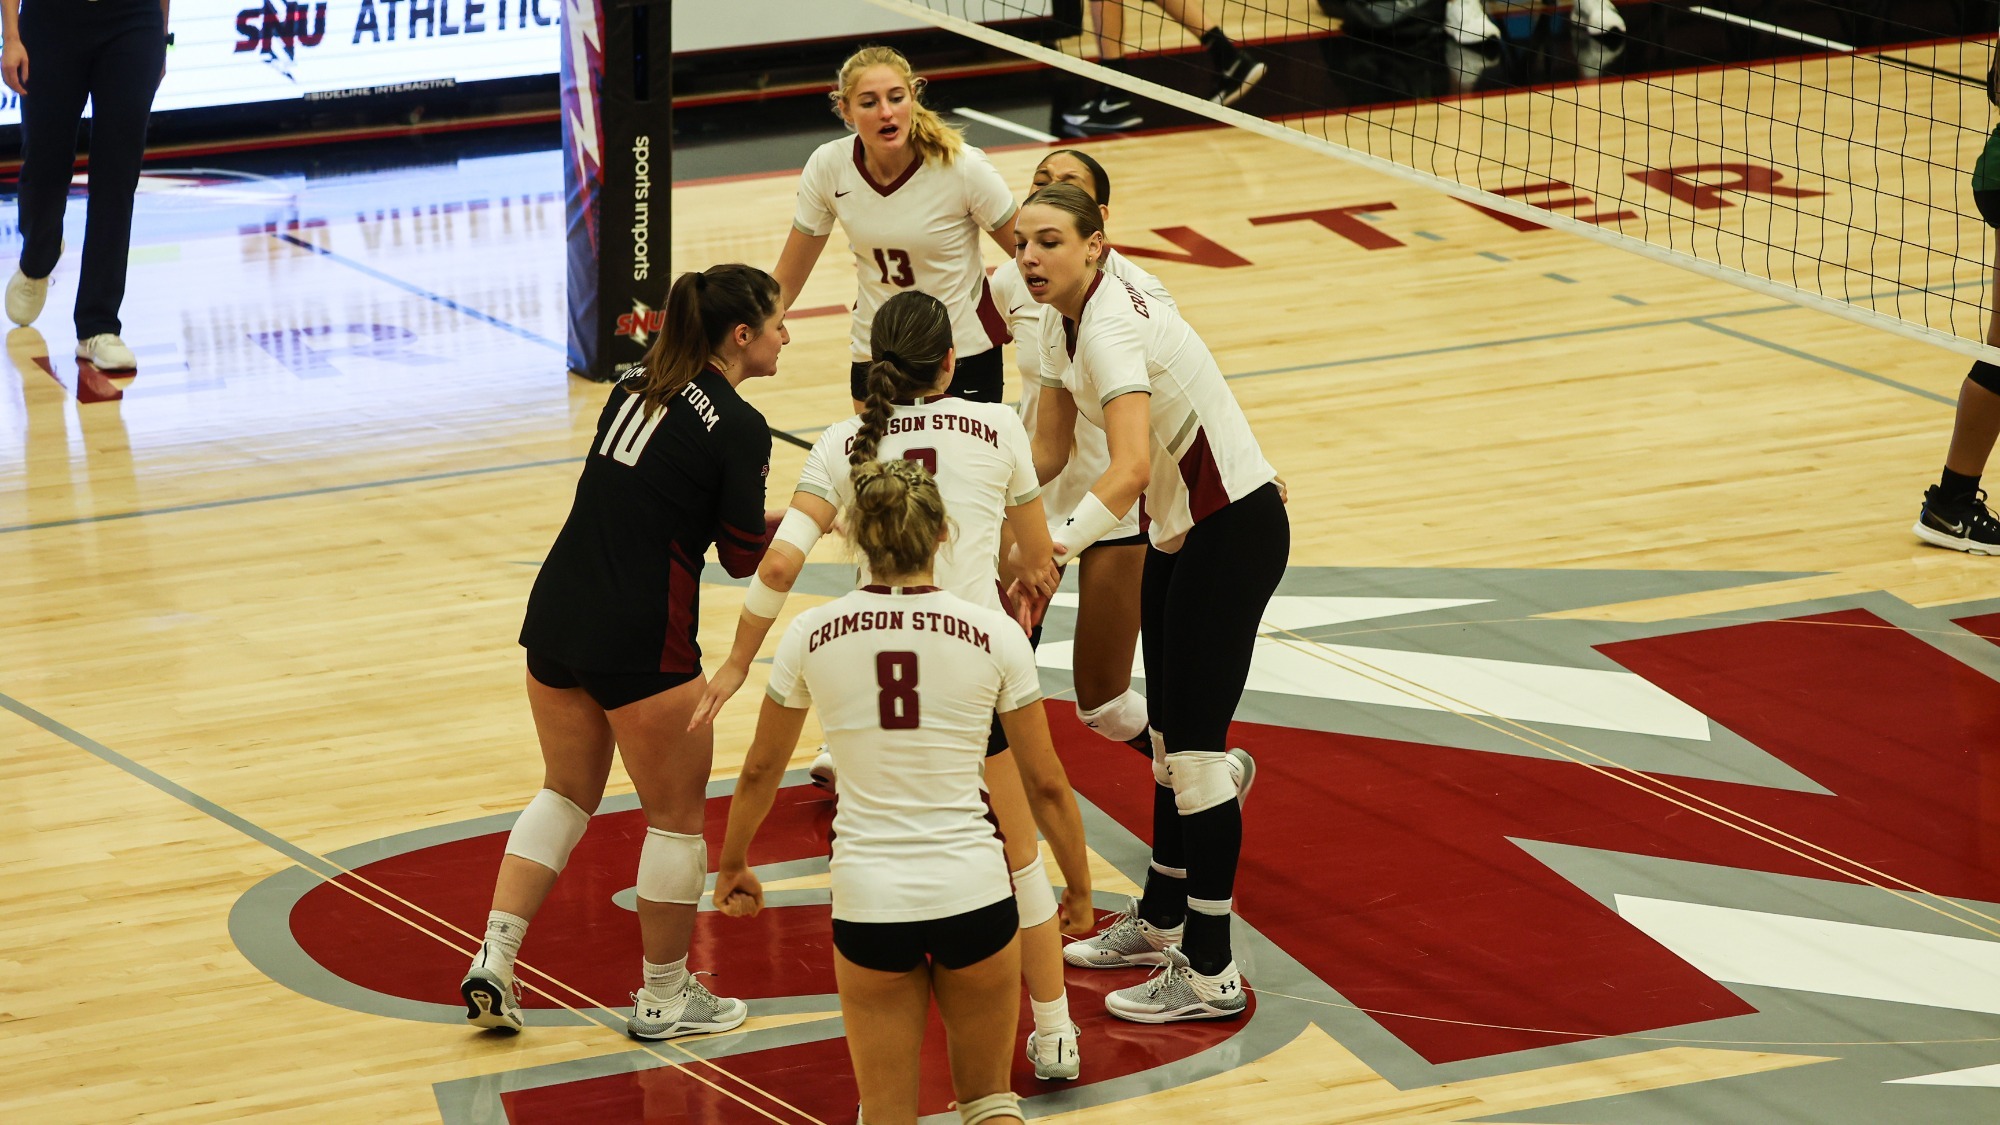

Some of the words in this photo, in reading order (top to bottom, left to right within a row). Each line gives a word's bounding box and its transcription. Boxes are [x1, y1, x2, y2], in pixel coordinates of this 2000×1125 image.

[234, 0, 327, 59] SNU
[374, 78, 455, 95] INTERACTIVE
[632, 135, 651, 200] sports
[631, 202, 651, 281] imports
[872, 247, 916, 288] 13
[615, 309, 667, 337] SNU
[598, 392, 669, 467] 10
[680, 381, 720, 433] TORM
[932, 414, 999, 449] STORM
[809, 611, 904, 653] CRIMSON
[912, 611, 991, 654] STORM
[876, 650, 920, 730] 8
